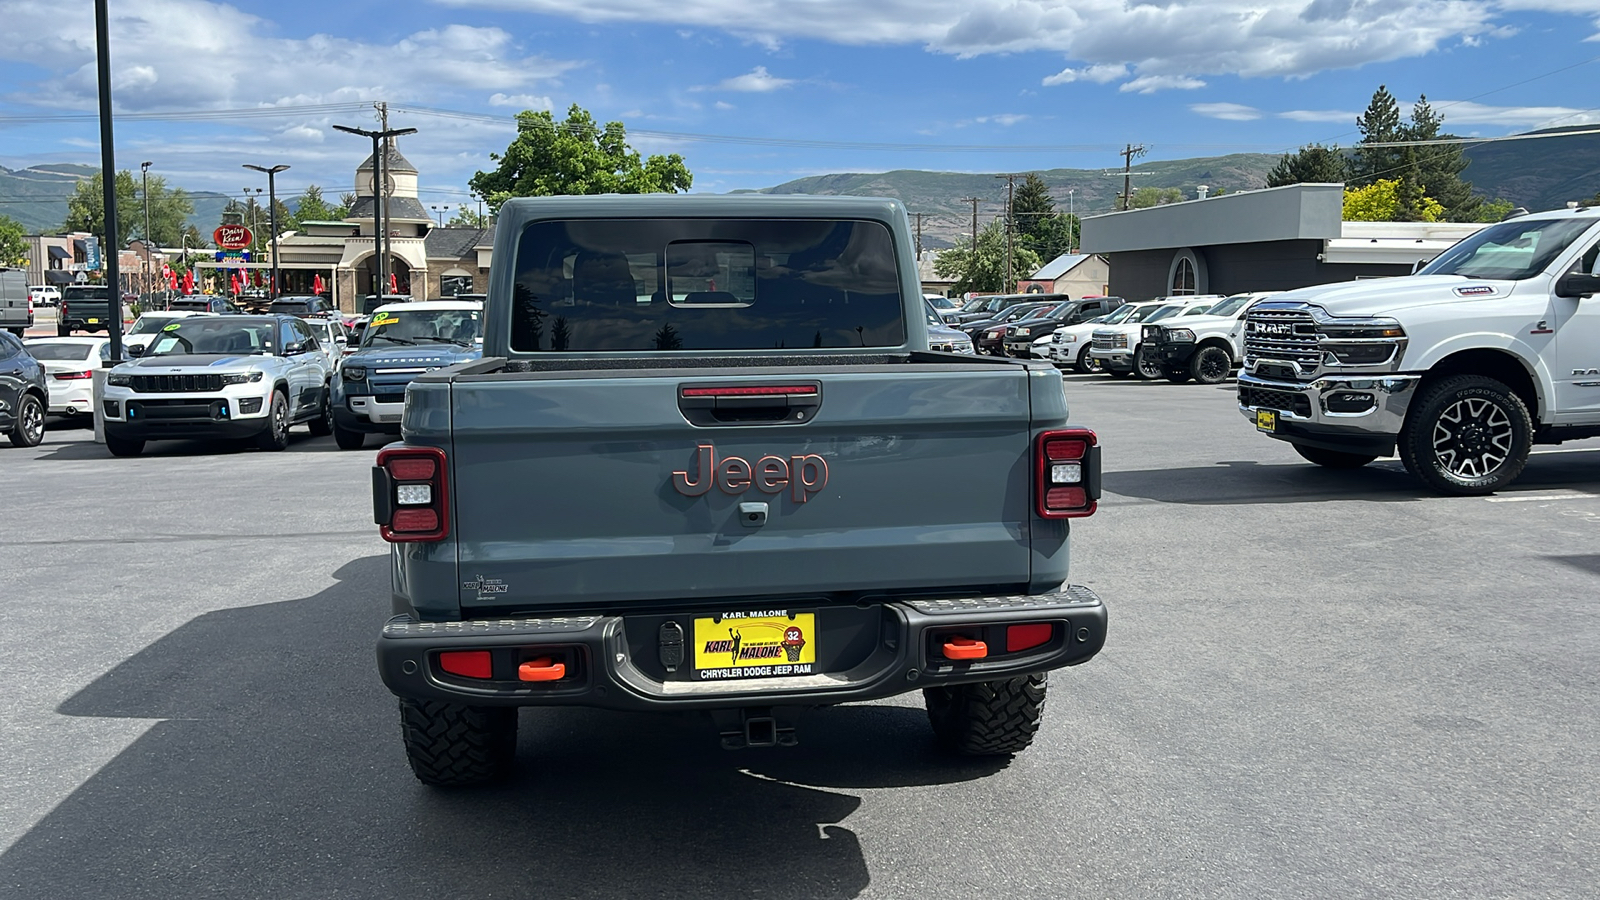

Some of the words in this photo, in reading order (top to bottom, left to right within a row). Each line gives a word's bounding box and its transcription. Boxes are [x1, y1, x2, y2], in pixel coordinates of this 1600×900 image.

[220, 227, 245, 240] Dairy
[222, 234, 241, 244] Keen
[1255, 323, 1292, 335] RAM
[1571, 367, 1600, 376] RA
[672, 444, 829, 503] Jeep
[722, 611, 747, 619] KARL
[749, 609, 788, 618] MALONE
[787, 630, 799, 641] 32
[703, 640, 733, 653] KARL
[739, 645, 782, 660] MALONE
[700, 668, 742, 679] CHRYSLER
[743, 667, 772, 676] DODGE
[772, 665, 792, 675] JEEP
[793, 664, 811, 673] RAM
